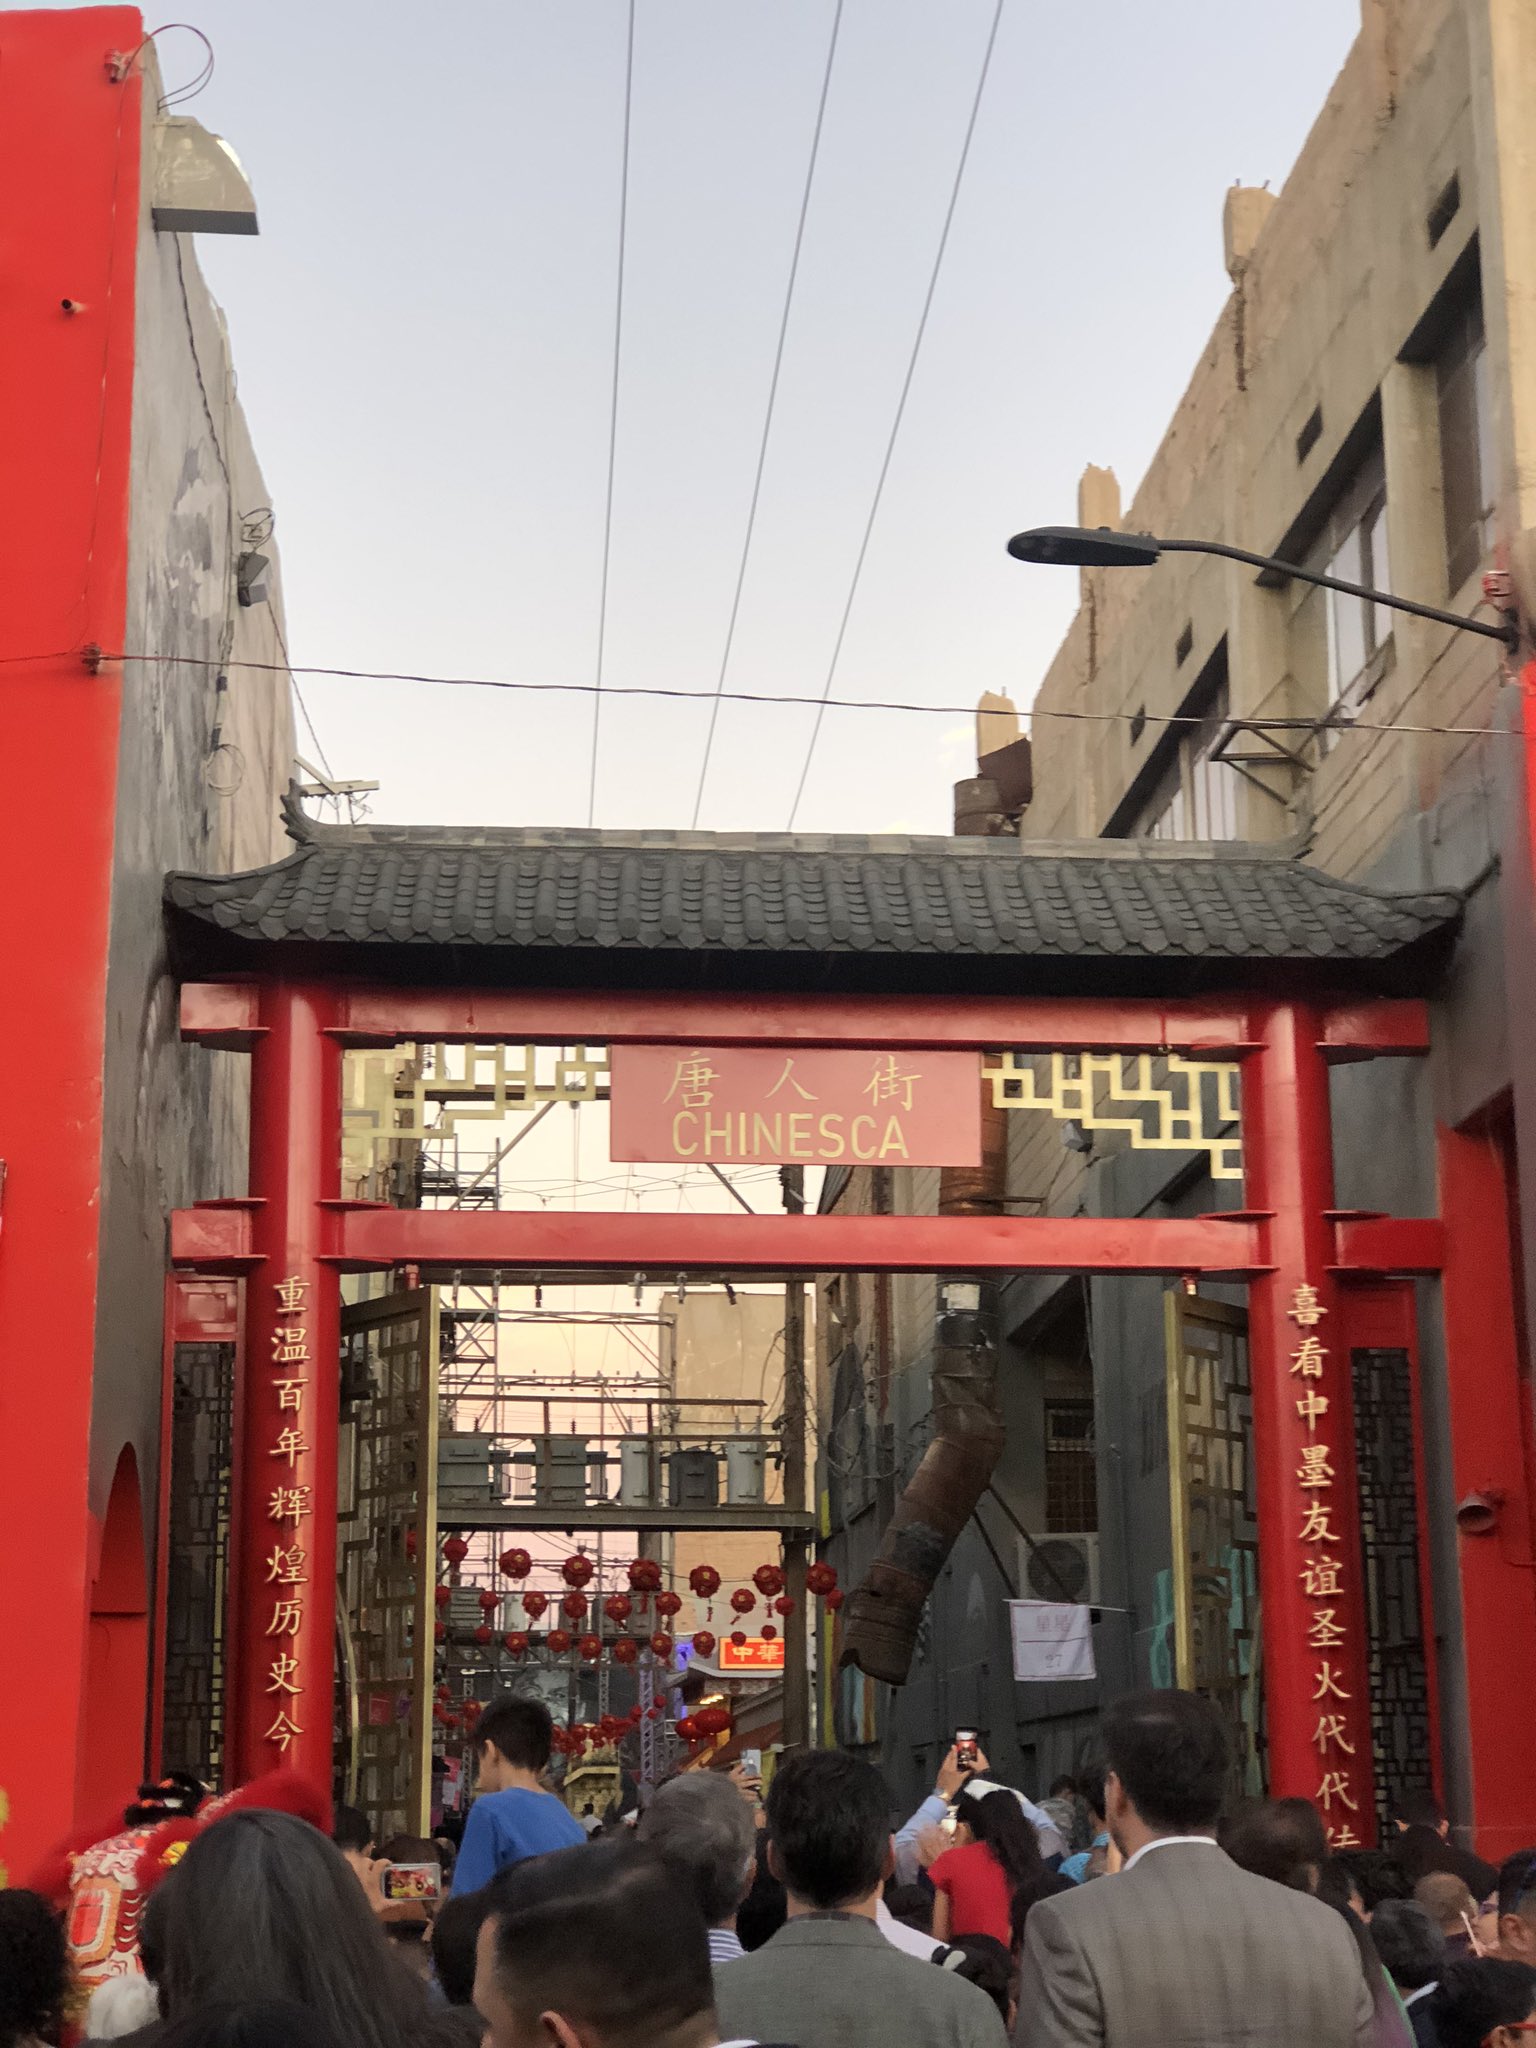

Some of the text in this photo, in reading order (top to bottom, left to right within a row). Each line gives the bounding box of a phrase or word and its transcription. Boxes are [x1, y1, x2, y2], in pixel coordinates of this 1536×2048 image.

[662, 1051, 923, 1111] 唐人街
[672, 1111, 909, 1159] CHINESCA
